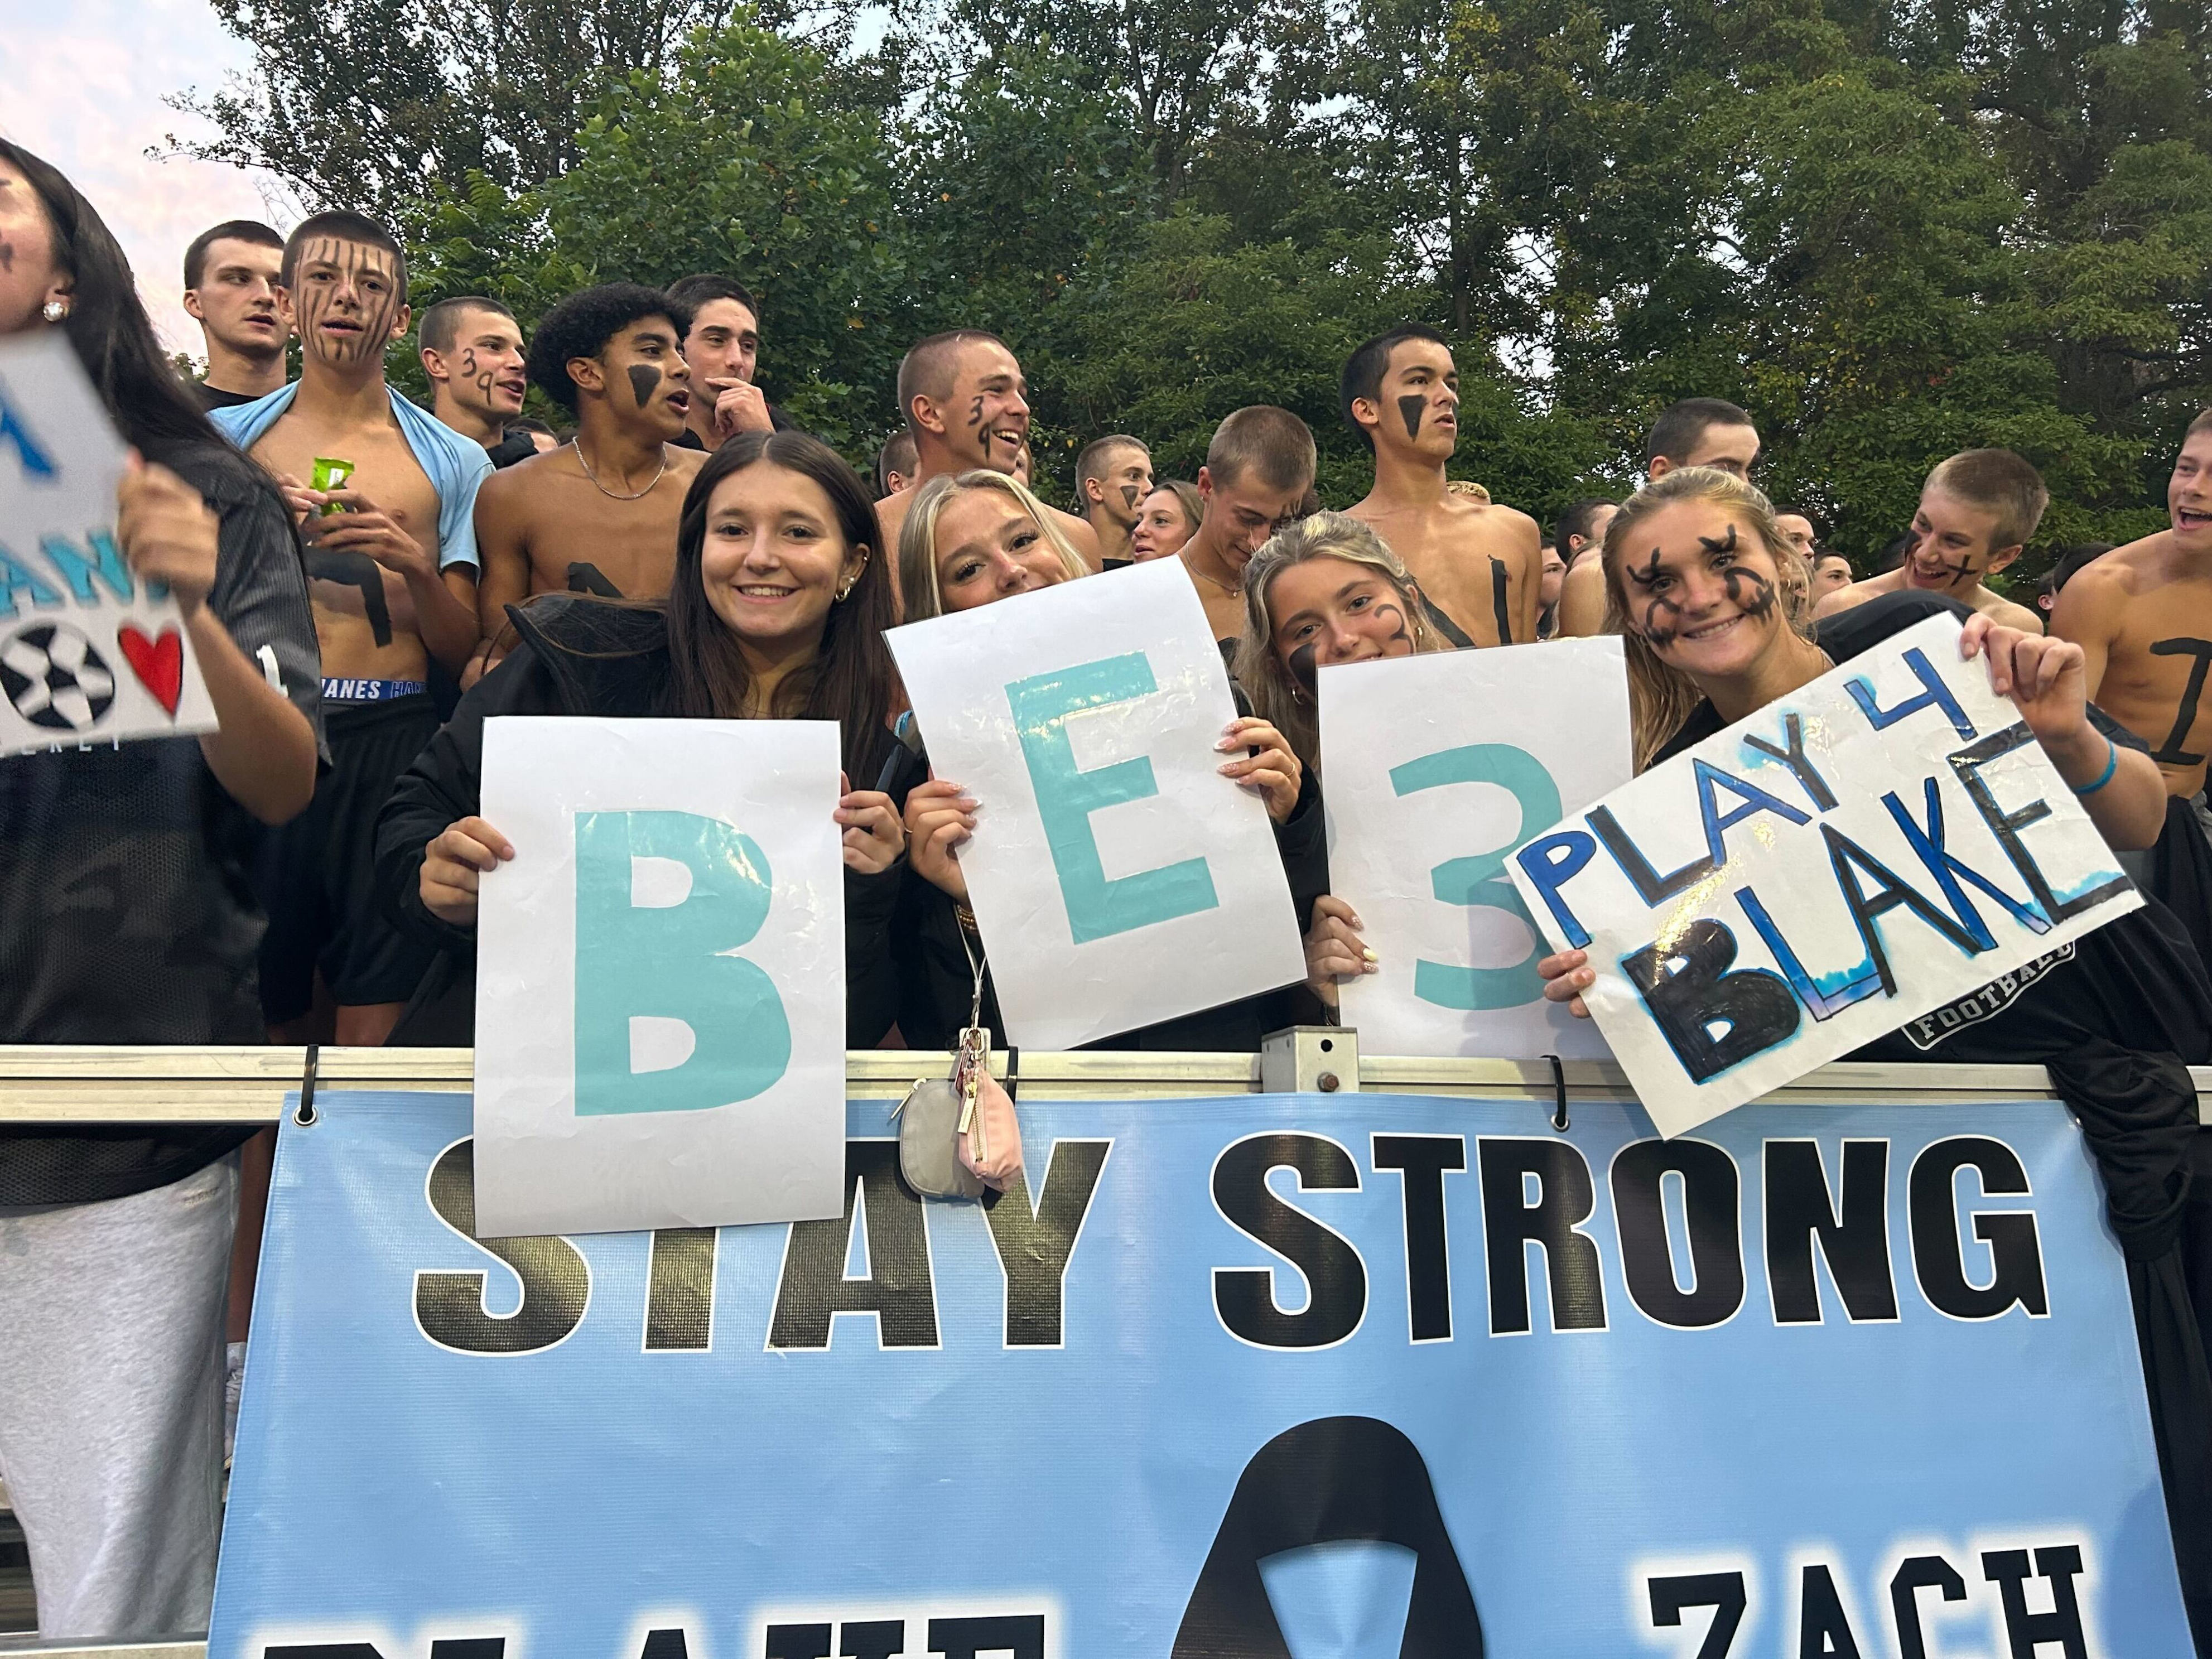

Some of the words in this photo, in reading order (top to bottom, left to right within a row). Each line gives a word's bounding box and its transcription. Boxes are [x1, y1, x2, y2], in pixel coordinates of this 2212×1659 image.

[461, 348, 494, 406] 39
[968, 395, 991, 459] 39
[321, 678, 382, 699] ANES
[1004, 649, 1220, 945] E
[1515, 714, 1839, 949] PLAY
[1844, 647, 1979, 741] 4
[575, 811, 792, 1116] B
[1389, 742, 1563, 1011] 3
[1621, 721, 2136, 1086] BLAKE
[1209, 1129, 2051, 1352] STRONG
